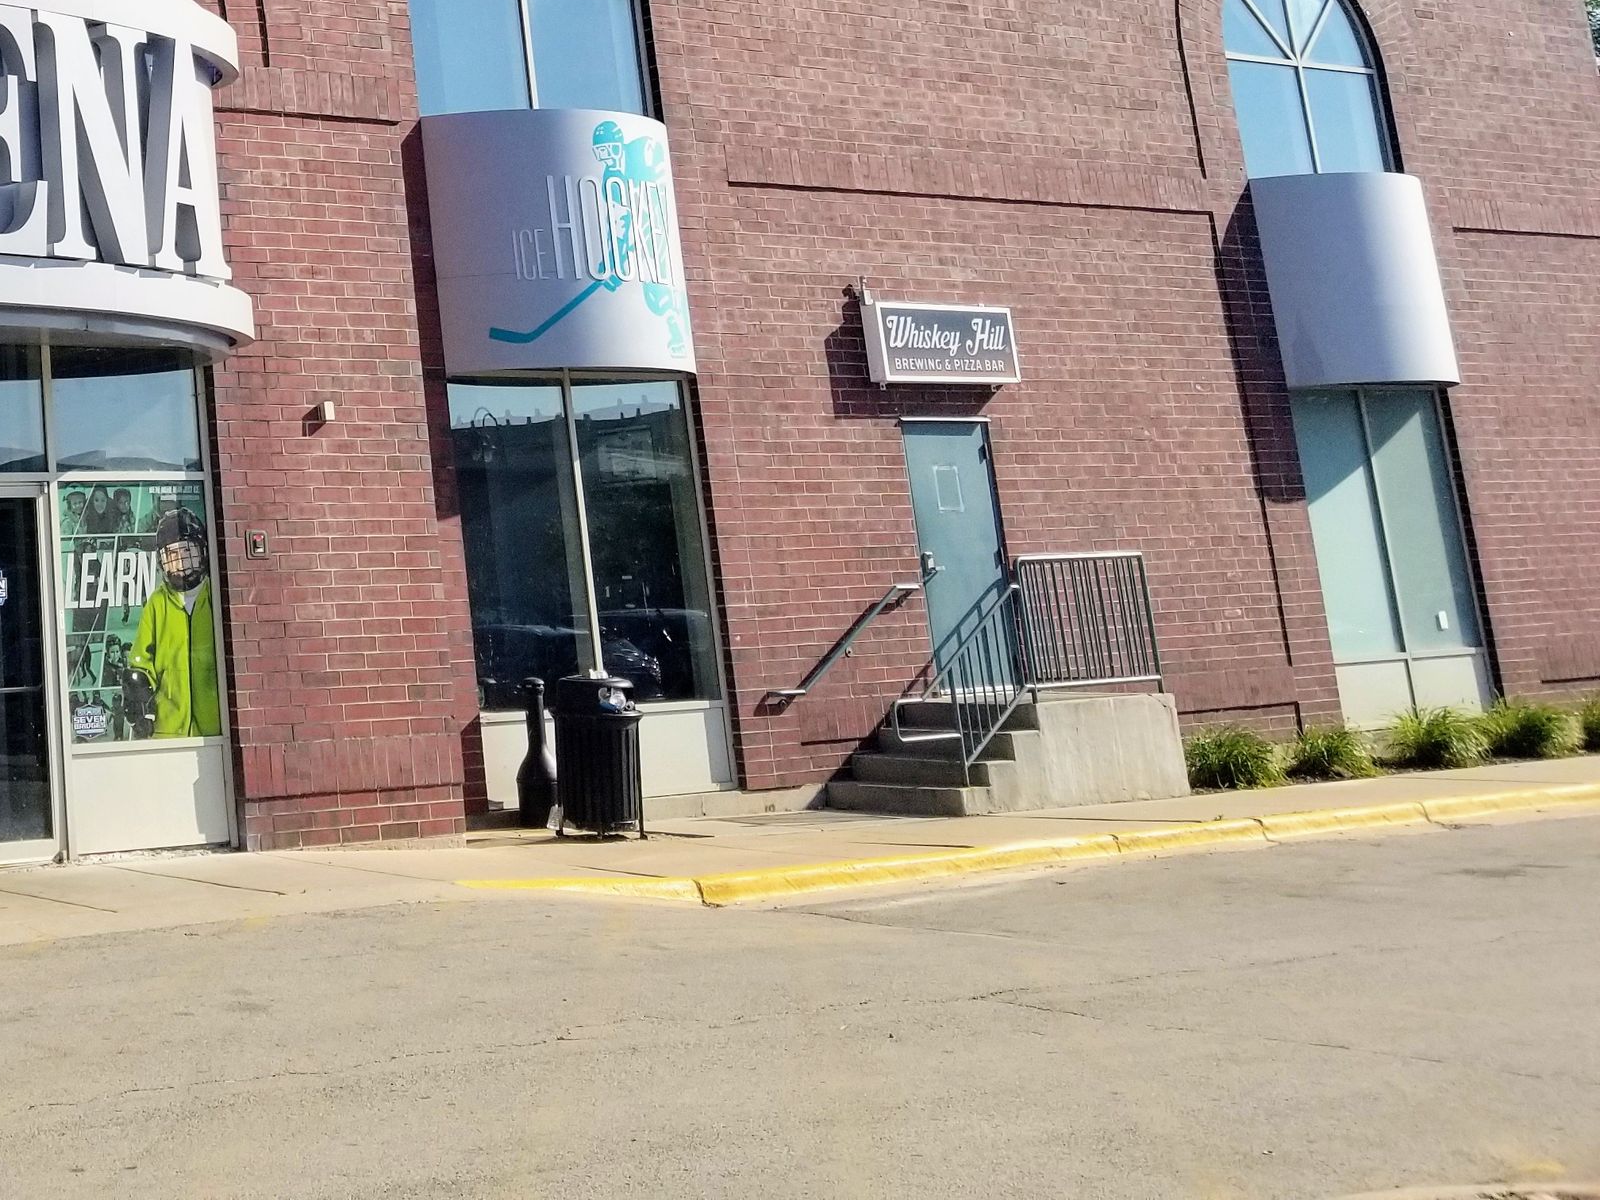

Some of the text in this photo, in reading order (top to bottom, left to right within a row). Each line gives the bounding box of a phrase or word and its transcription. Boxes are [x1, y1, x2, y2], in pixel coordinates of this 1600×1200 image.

[512, 175, 676, 286] ICE HOCKEY
[886, 316, 1006, 356] Whiskey Hill
[895, 358, 1005, 371] BREWING & PIZZA BAR
[65, 551, 157, 609] LEARN
[74, 716, 105, 724] SEVEN
